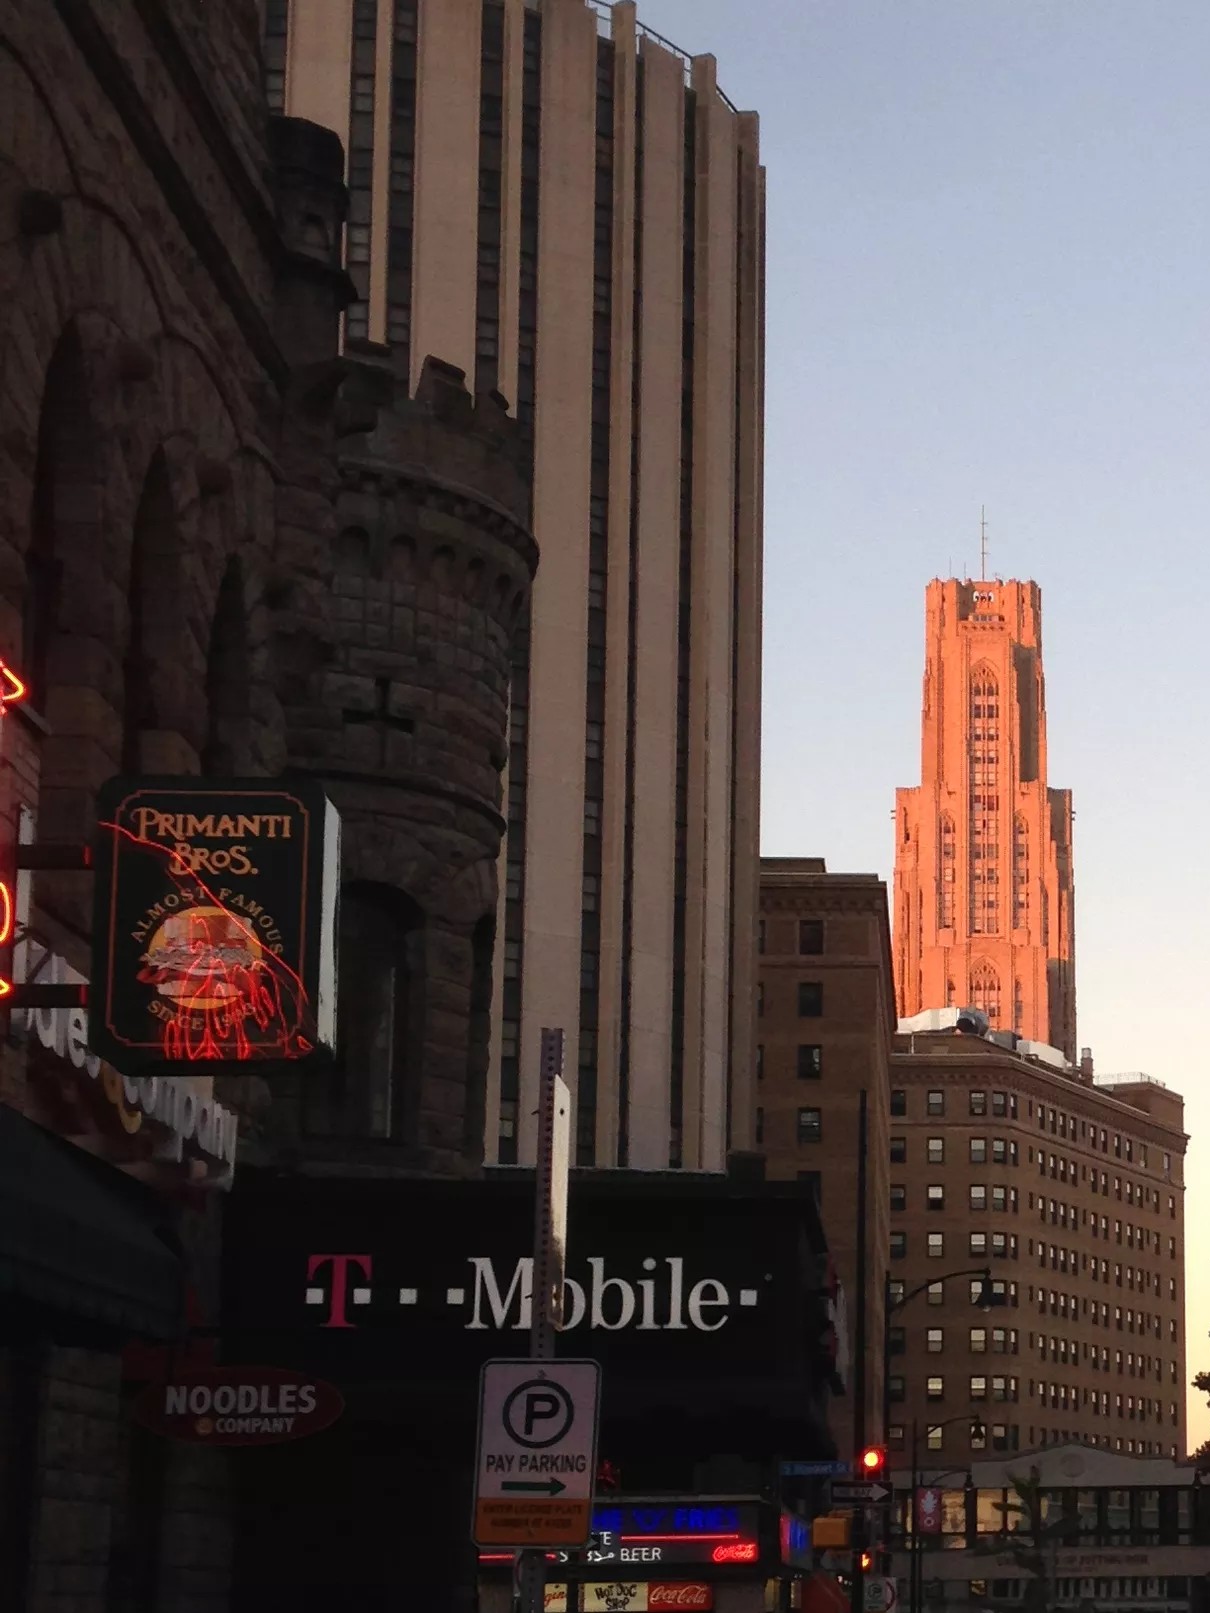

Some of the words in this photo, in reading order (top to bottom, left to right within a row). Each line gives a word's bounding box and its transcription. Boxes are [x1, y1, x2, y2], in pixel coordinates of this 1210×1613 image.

[130, 806, 292, 841] PRIMANTI
[130, 886, 208, 943] ALMOST
[218, 887, 284, 955] FAMOUS
[164, 1384, 317, 1415] NOODLES
[524, 1394, 560, 1435] P
[215, 1417, 298, 1435] COMPANY
[486, 1454, 514, 1473] PAY
[518, 1454, 586, 1473] PARKING
[620, 1547, 661, 1562] BEER
